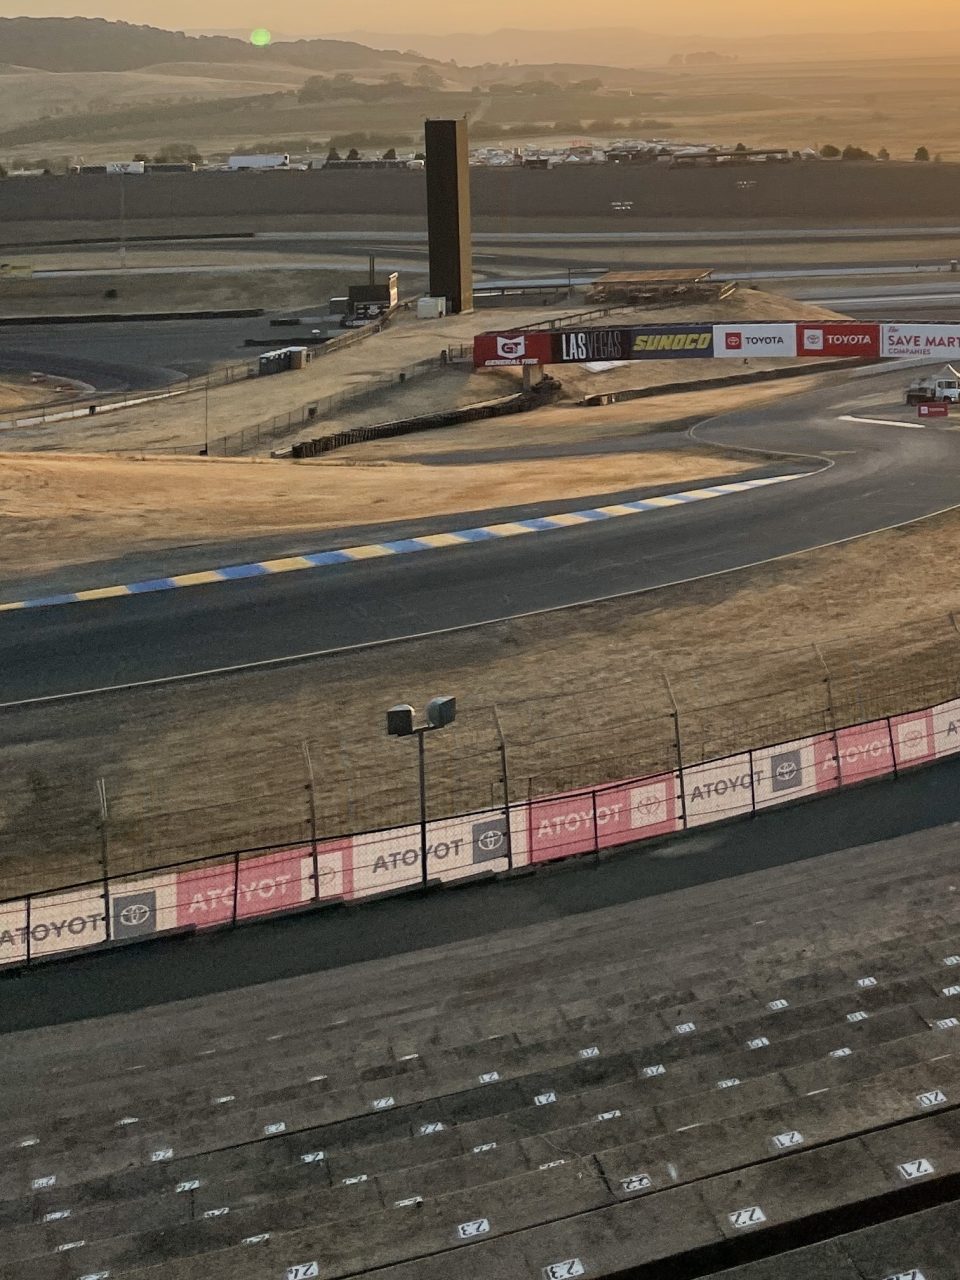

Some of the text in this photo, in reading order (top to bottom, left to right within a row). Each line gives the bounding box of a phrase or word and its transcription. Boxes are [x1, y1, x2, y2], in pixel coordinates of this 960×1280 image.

[561, 331, 622, 360] LAS VEGAS
[633, 333, 712, 351] SUNOCO
[745, 336, 784, 345] TOYOTA
[827, 334, 872, 344] TOYOTA
[888, 336, 921, 347] SAVE
[919, 1091, 944, 1106] 20
[776, 1133, 802, 1147] 21
[900, 1161, 928, 1177] 21
[731, 1208, 761, 1226] 22
[460, 1220, 486, 1236] 23
[550, 1260, 580, 1279] 23
